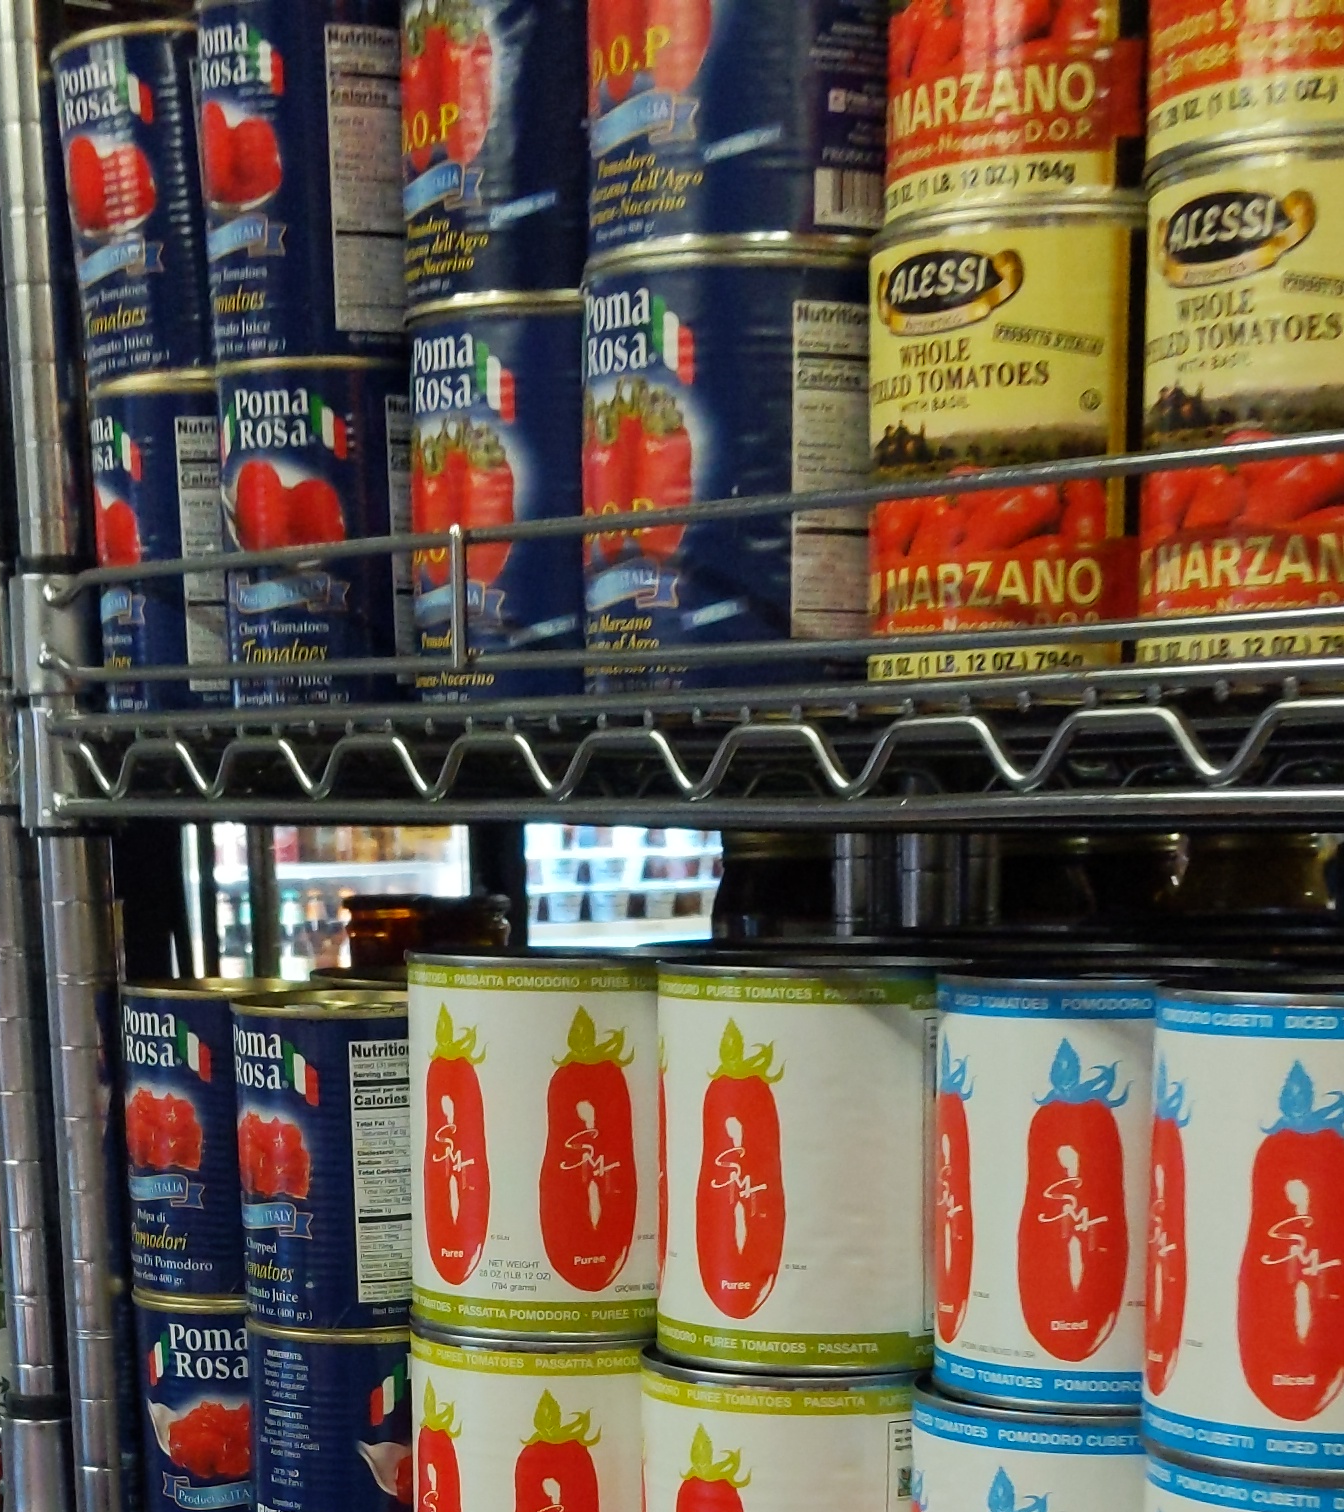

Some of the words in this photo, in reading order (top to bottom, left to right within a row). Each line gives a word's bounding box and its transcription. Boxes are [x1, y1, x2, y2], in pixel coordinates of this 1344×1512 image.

[60, 59, 118, 98] Poma
[64, 85, 118, 125] Rosa
[330, 87, 389, 104] Calories
[894, 61, 1095, 134] MARZANO
[630, 168, 703, 198] dell'Agro
[1168, 197, 1277, 249] ALESSI
[891, 252, 987, 302] ALESSI
[585, 288, 650, 334] Poma
[1176, 290, 1254, 322] WHOLE
[1196, 313, 1342, 354] TOMATOES
[414, 334, 473, 370] Poma
[587, 331, 648, 375] Rosa
[900, 338, 970, 368] WHOLE
[918, 360, 1050, 395] TOMATOES
[235, 388, 309, 420] Poma
[415, 373, 472, 413] Rosa
[241, 418, 309, 448] Rosa
[888, 557, 1102, 614] MARZANO
[239, 621, 270, 637] Cherry
[272, 621, 329, 634] Tomatoes
[242, 641, 328, 663] Tomatoes
[454, 974, 502, 987] PASSATTA
[506, 975, 579, 989] POMODORO
[706, 986, 741, 999] PUREE
[744, 988, 813, 1001] TOMATOES
[124, 1006, 175, 1038] Poma
[127, 1036, 175, 1068] Rosa
[235, 1025, 282, 1060] Poma
[236, 1056, 282, 1090] Rosa
[354, 1092, 408, 1107] Calories
[265, 1209, 293, 1225] ITALY
[246, 1238, 277, 1255] Chopped
[573, 1254, 606, 1265] Puree
[162, 1257, 212, 1273] Pomodoro
[506, 1259, 539, 1270] WEIGHT
[272, 1288, 298, 1304] Juice
[721, 1278, 751, 1291] Puree
[458, 1305, 506, 1321] PASSATTA
[509, 1308, 580, 1322] POMODORO
[591, 1309, 632, 1321] PUREE
[169, 1322, 247, 1354] Poma
[704, 1336, 737, 1351] PUREE
[739, 1339, 806, 1355] TOMATOES
[817, 1341, 878, 1355] PASSATTA
[175, 1355, 248, 1380] Rosa
[436, 1352, 465, 1364] PUREE
[467, 1355, 524, 1369] TOMATOES
[535, 1357, 595, 1370] PASSATTA
[979, 1371, 1043, 1391] TOMATOES
[1054, 1378, 1141, 1393] POMODORO
[998, 1428, 1082, 1448] POMODORO
[1266, 1438, 1318, 1456] DICED
